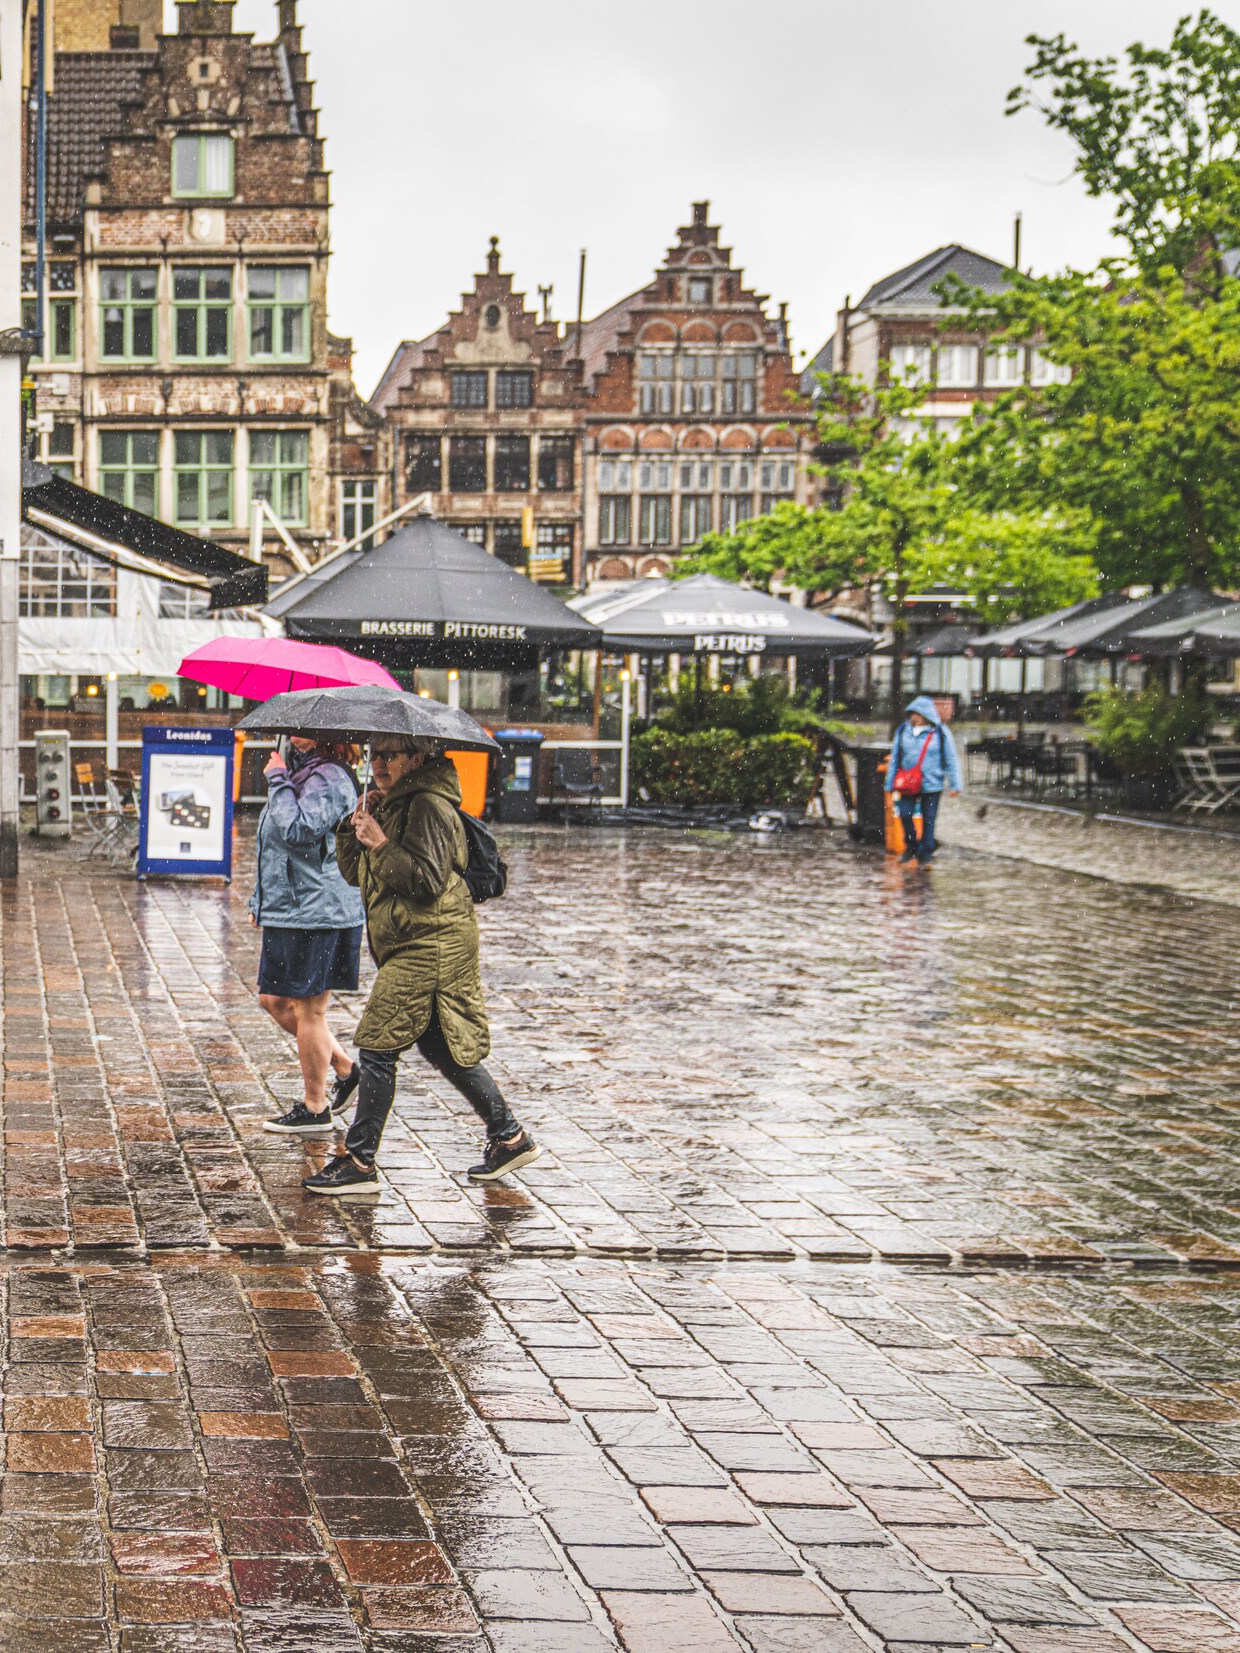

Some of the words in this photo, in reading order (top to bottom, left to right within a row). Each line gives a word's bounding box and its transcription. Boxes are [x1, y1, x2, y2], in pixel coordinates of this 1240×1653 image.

[662, 612, 790, 628] PETRUS
[360, 621, 435, 636] BRASSERIE
[444, 622, 527, 640] PITTORESK
[694, 635, 766, 653] PETRUS
[166, 729, 213, 741] Leonidas
